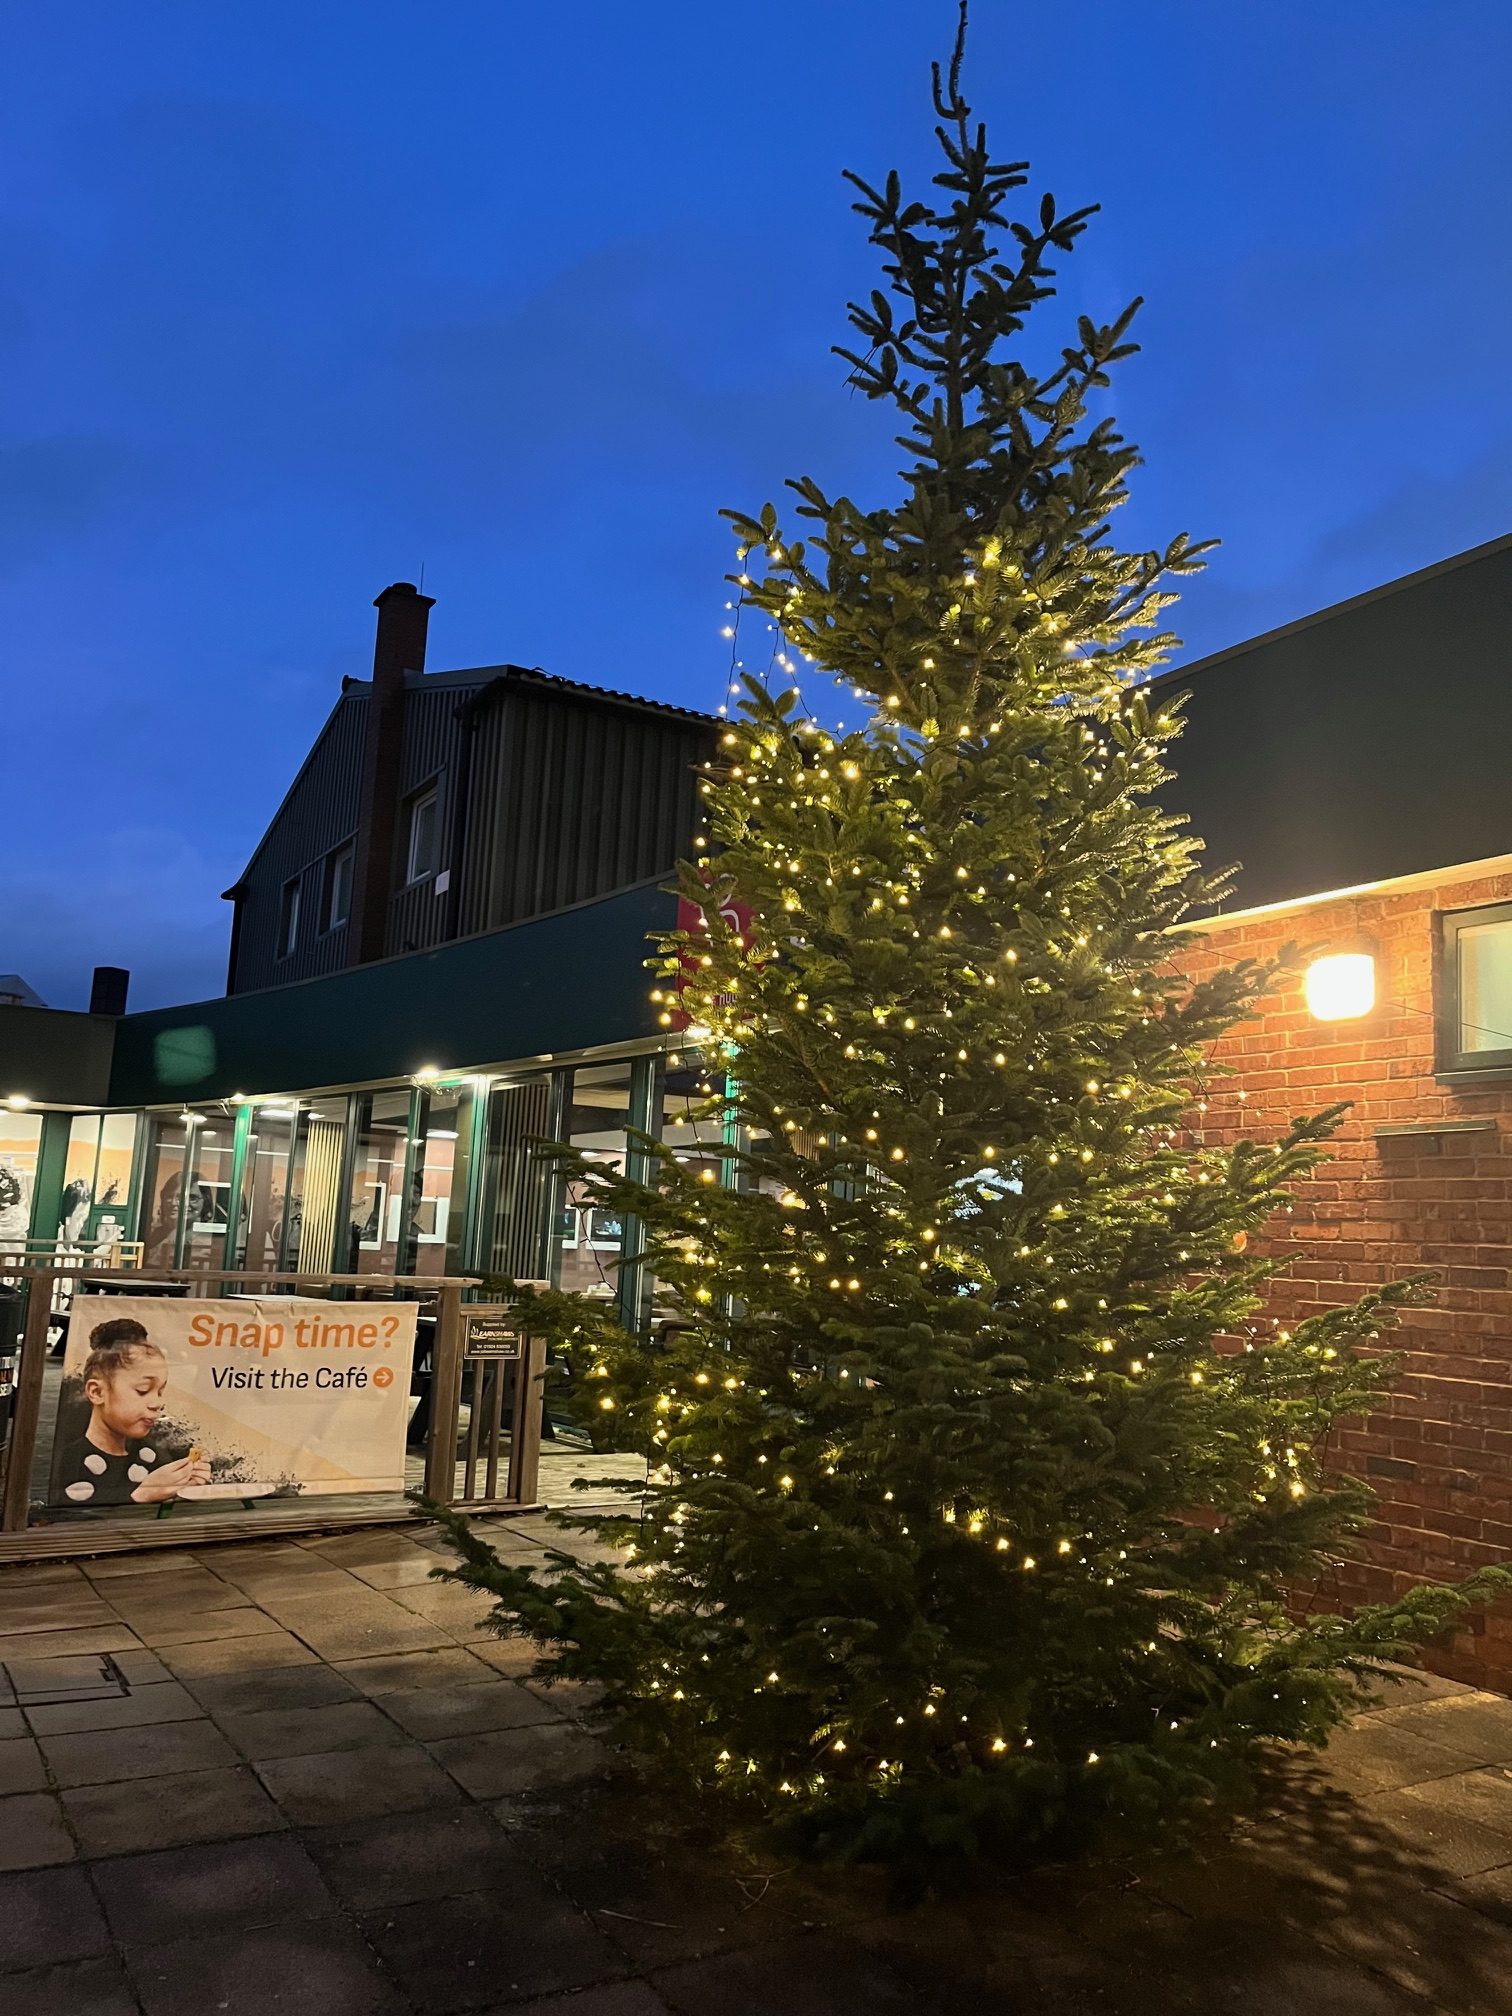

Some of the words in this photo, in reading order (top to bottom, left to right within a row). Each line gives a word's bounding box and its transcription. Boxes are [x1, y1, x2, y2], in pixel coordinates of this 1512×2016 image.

[188, 1314, 284, 1357] Snap
[294, 1315, 400, 1349] time?
[211, 1366, 264, 1389] Visit
[270, 1367, 309, 1389] the
[315, 1366, 368, 1388] Café
